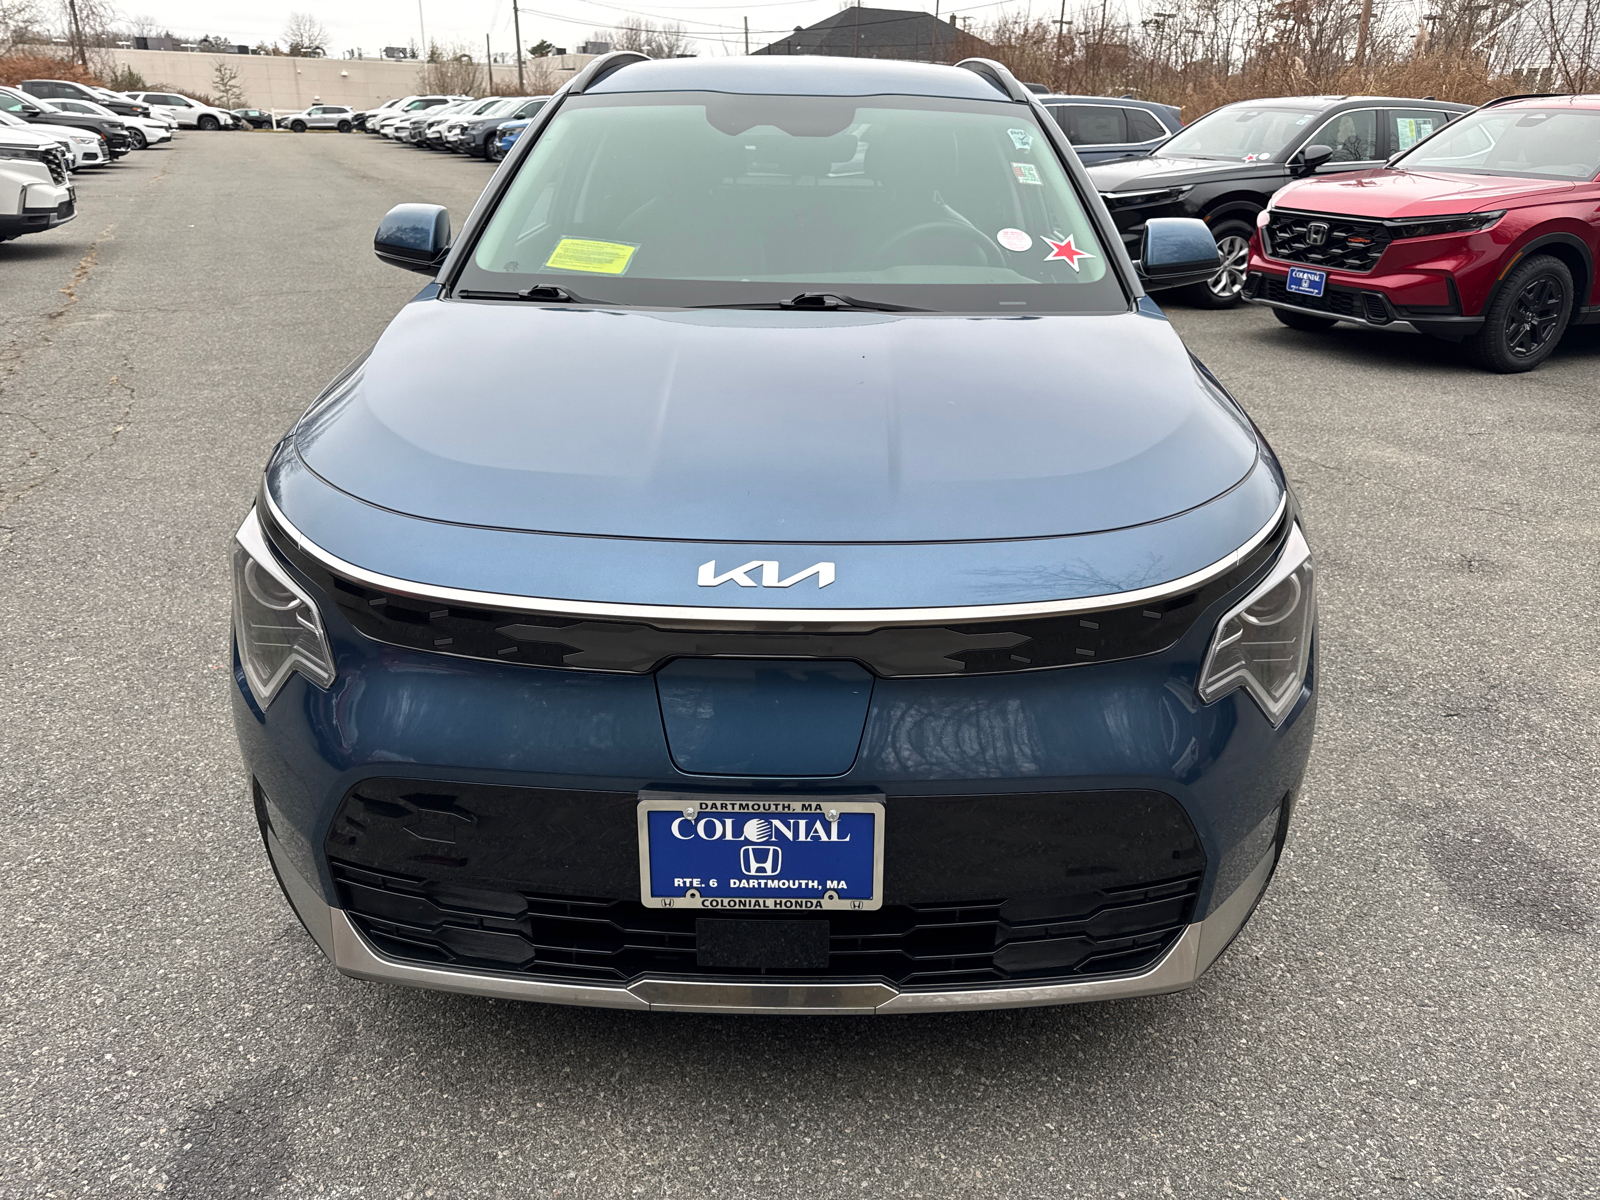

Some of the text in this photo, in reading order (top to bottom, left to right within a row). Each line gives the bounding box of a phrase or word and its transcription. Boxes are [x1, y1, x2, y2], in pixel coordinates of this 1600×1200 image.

[697, 559, 836, 590] KIA
[699, 802, 823, 812] DARTMOUTH, MA
[671, 817, 851, 842] COLONIAL
[673, 878, 848, 891] RTE. 6 DARTMOUTH, MA
[701, 898, 824, 910] COLONIAL HONDA
